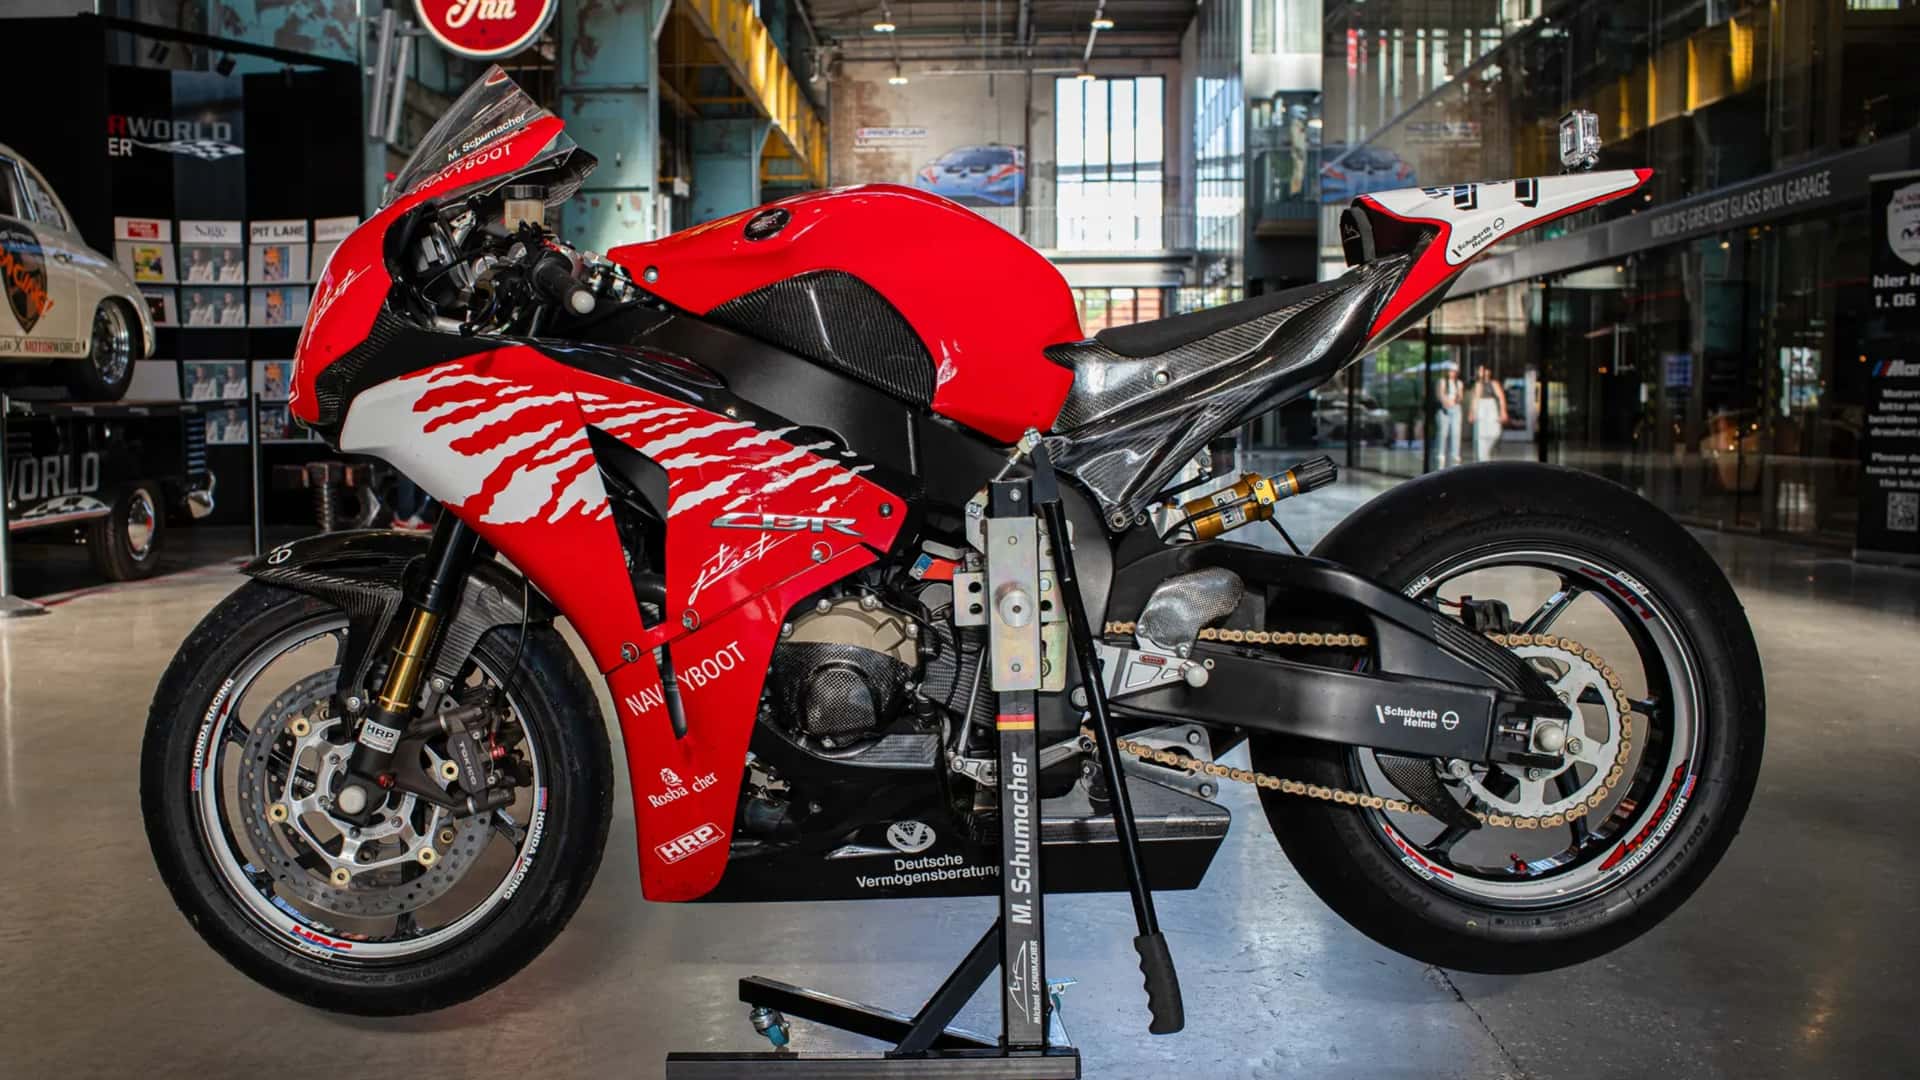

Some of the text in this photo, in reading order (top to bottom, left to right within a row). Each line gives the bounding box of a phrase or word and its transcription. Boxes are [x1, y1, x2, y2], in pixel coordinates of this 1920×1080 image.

[463, 113, 527, 151] Schumacher
[1730, 189, 1762, 218] GLASS
[1763, 182, 1785, 211] BOX
[1785, 170, 1831, 204] GARAGE
[252, 226, 304, 237] PIT LANE
[710, 512, 864, 537] CBR
[193, 678, 235, 768] HONDA RACING
[1384, 705, 1438, 720] Schuberth
[1403, 717, 1437, 729] Helme
[367, 724, 395, 739] HRP
[459, 741, 477, 785] TOKICO
[1007, 752, 1032, 893] Schumacher
[1619, 797, 1688, 875] HONDA RACING
[503, 811, 545, 900] HONDA RACING
[660, 825, 714, 859] HRP
[894, 854, 963, 871] Deutsche
[1011, 899, 1032, 924] M.
[1030, 940, 1040, 992] SCHUMACHER
